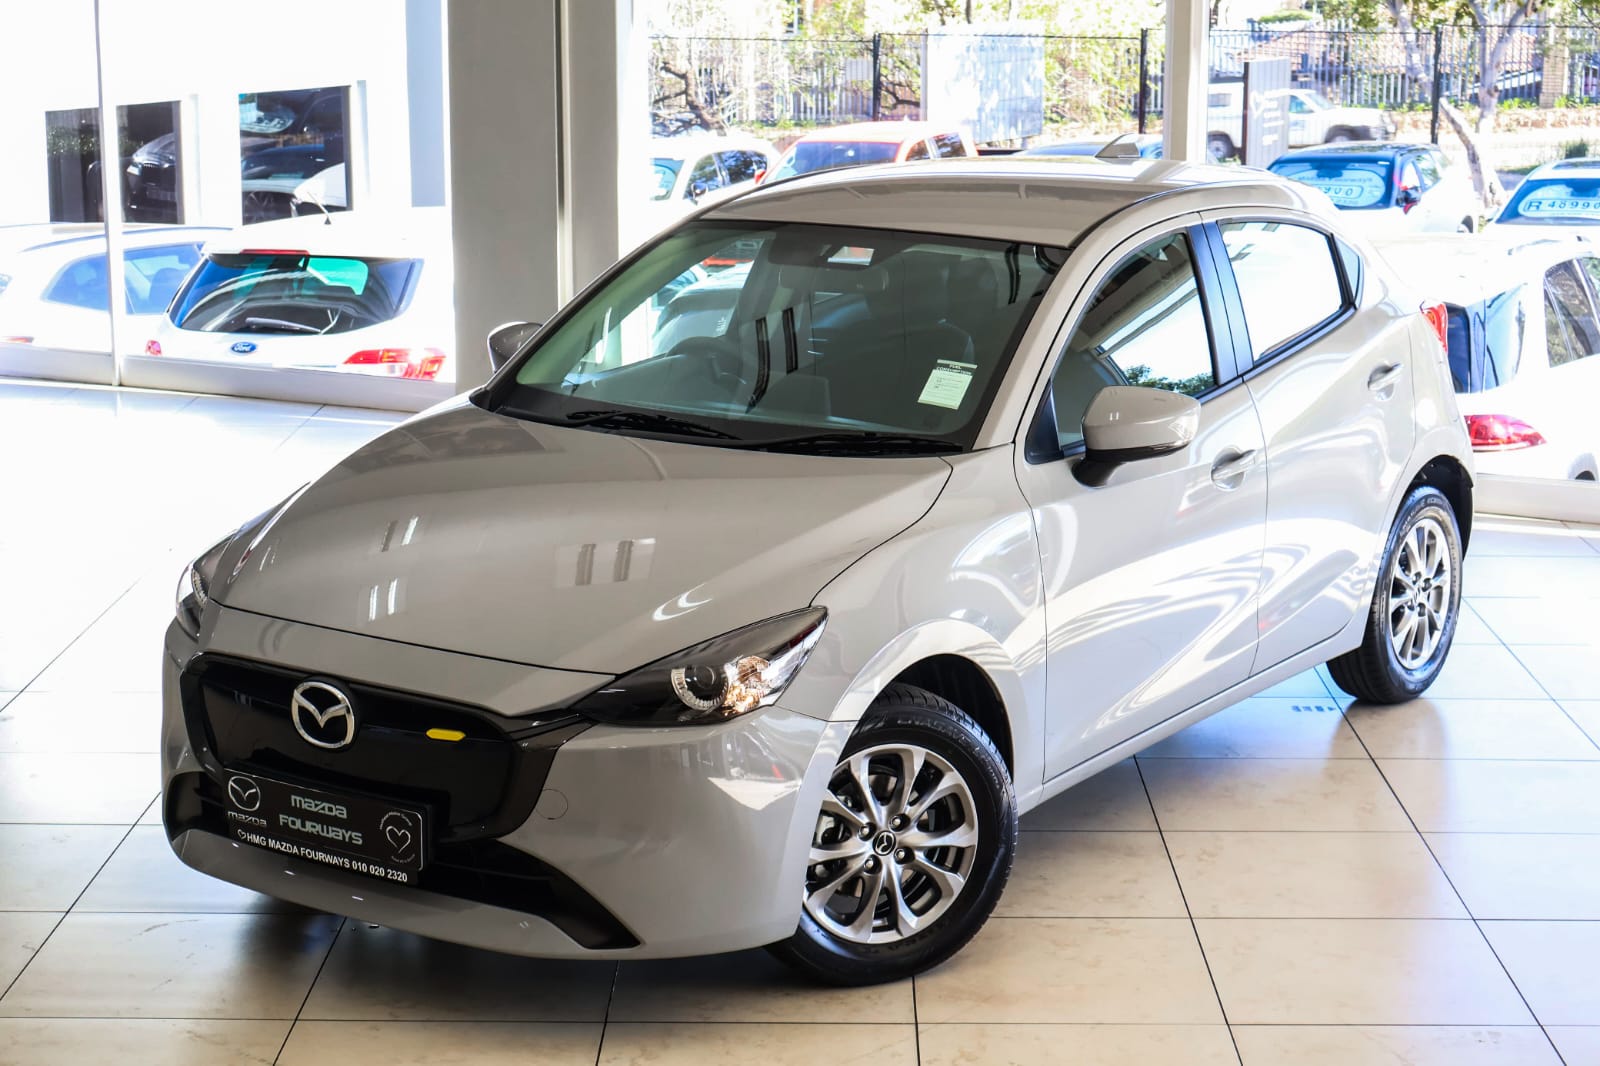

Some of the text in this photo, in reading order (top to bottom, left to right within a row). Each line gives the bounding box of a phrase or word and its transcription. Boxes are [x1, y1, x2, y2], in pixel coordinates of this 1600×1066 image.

[246, 832, 408, 883] HMG MAZDA FOURWAYS 010 020 2320
